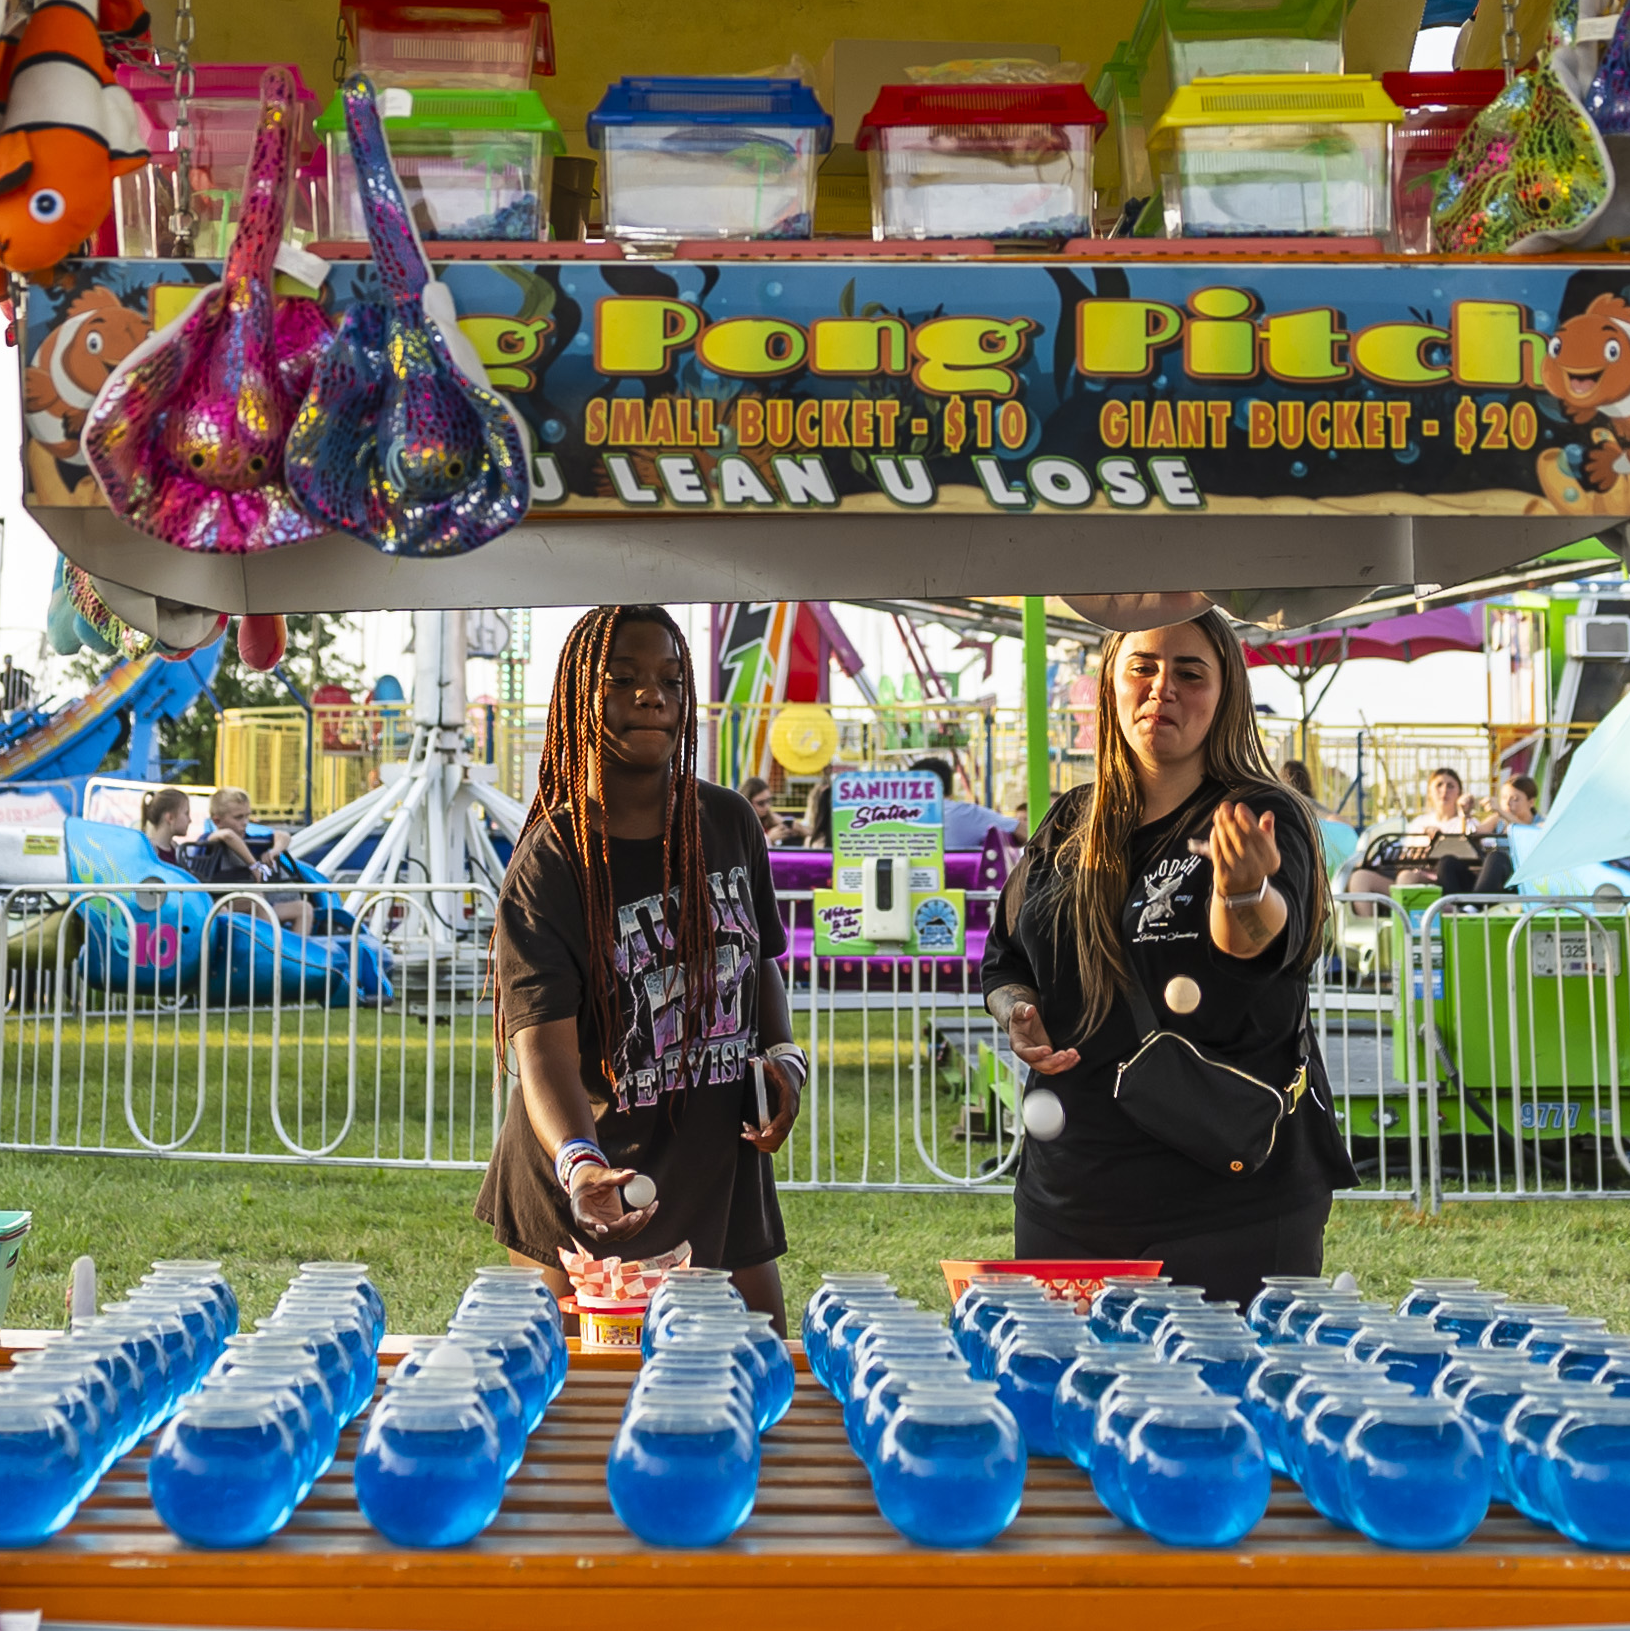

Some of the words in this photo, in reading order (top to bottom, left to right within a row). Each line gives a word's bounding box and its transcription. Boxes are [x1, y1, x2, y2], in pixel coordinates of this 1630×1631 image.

[594, 295, 1037, 397] Pong
[1076, 286, 1549, 388] Pitch
[585, 397, 720, 447] SMALL
[736, 399, 901, 448] BUCKET
[944, 394, 1028, 453] $10
[1100, 399, 1230, 448] GIANT
[1249, 401, 1411, 449] BUCKET
[1454, 397, 1538, 454] $20
[603, 452, 841, 507] LEAN
[870, 453, 938, 507] U
[971, 455, 1208, 510] LOSE
[840, 781, 935, 800] SANITIZE
[851, 804, 922, 829] Station
[135, 922, 178, 969] 10
[612, 866, 760, 982] MUIC
